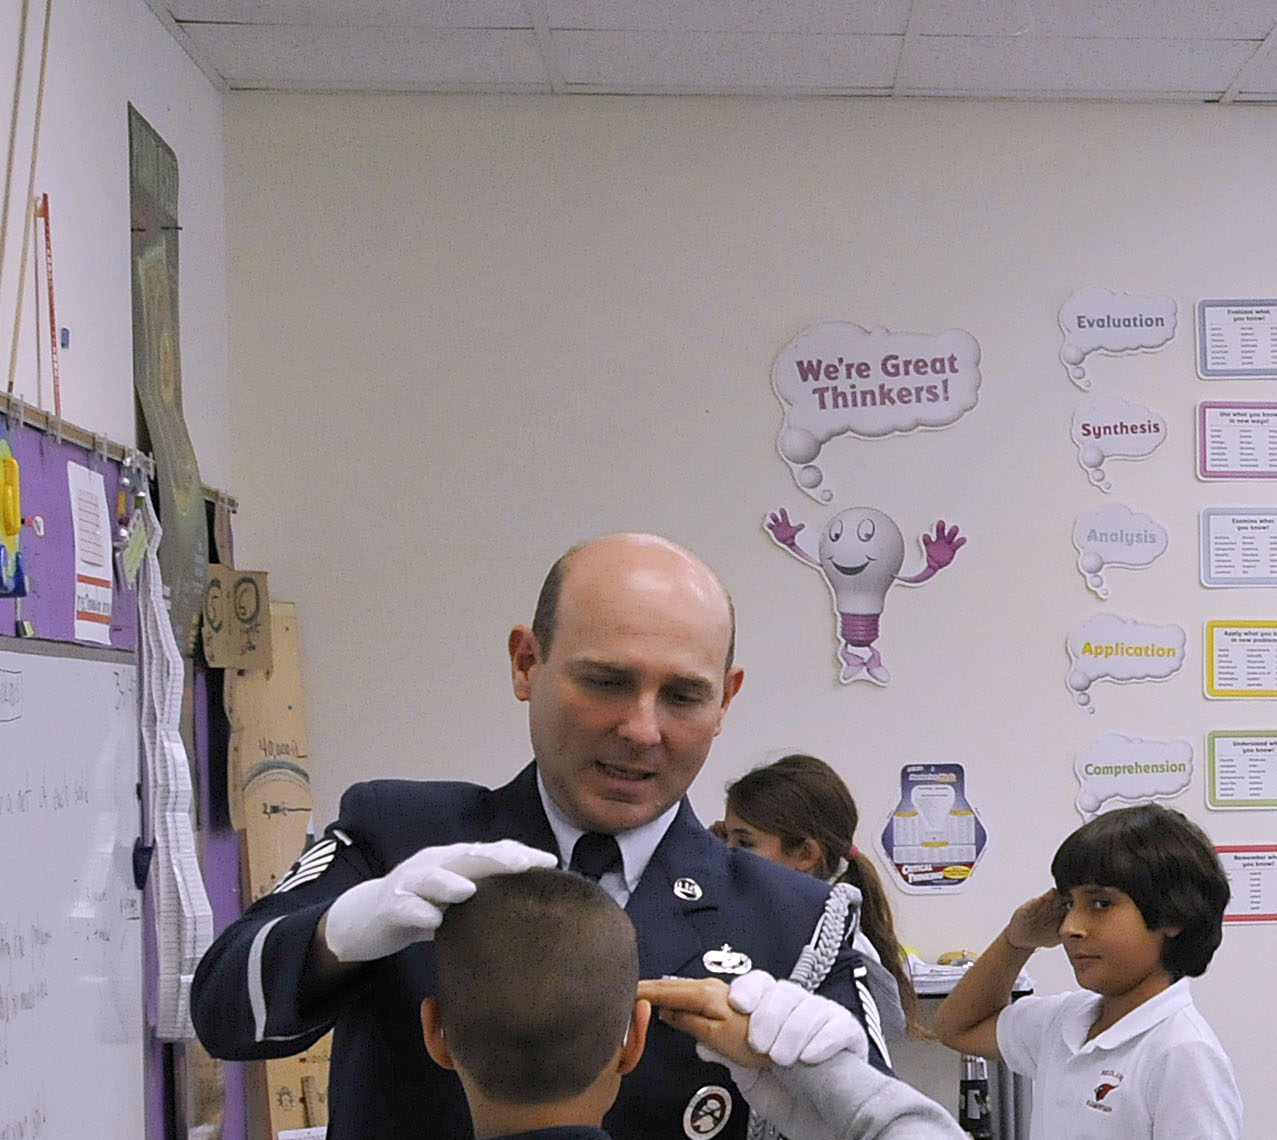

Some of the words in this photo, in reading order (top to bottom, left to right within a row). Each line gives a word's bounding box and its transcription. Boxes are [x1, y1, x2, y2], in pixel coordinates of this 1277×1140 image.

[1077, 314, 1165, 328] Evaluation
[796, 357, 871, 383] We're
[880, 352, 959, 378] Great
[812, 378, 950, 411] Thinkers!
[1081, 420, 1160, 439] Synthesis
[1087, 528, 1157, 546] Analysis
[1081, 641, 1176, 658] Application
[1084, 760, 1187, 777] Comprehension
